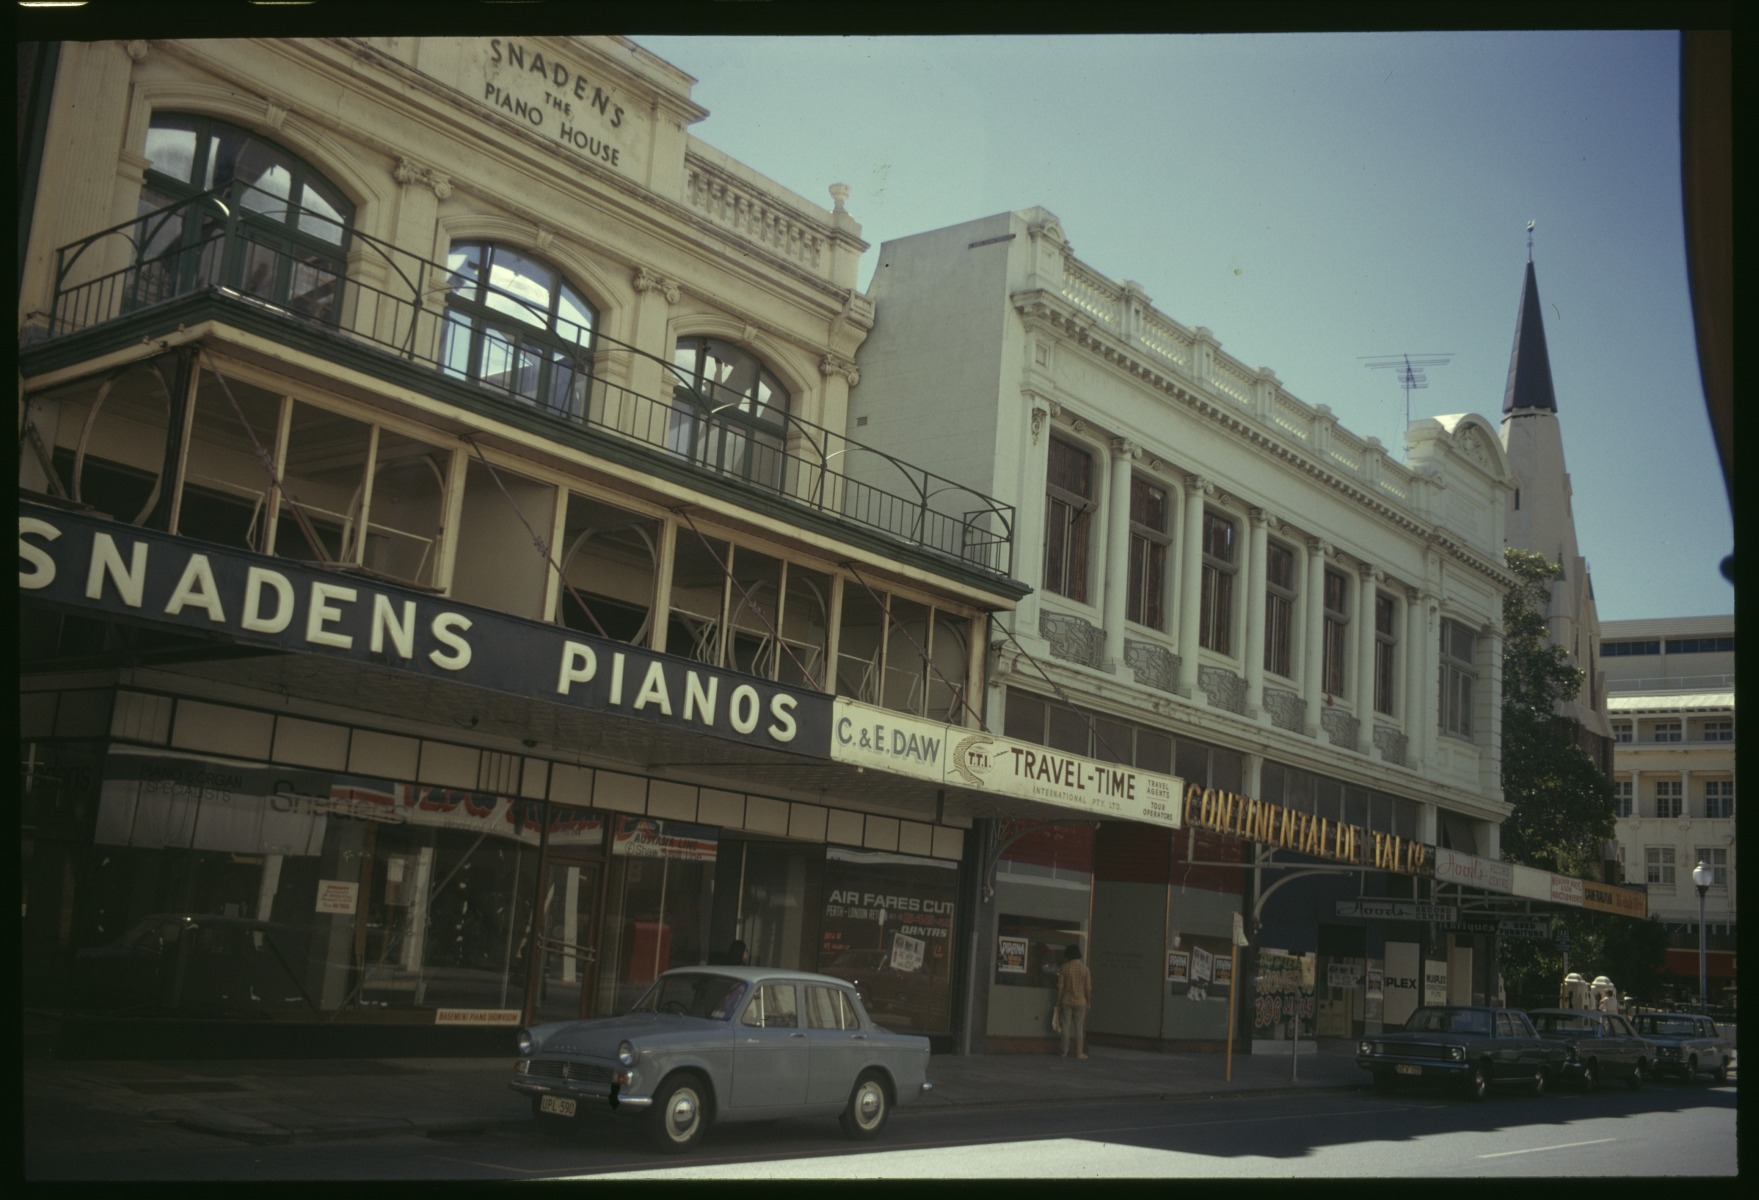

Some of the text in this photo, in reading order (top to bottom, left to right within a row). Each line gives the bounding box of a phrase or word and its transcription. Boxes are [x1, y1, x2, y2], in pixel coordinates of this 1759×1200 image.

[490, 39, 625, 128] SNADENS
[544, 91, 572, 116] THE
[485, 82, 620, 167] PIANO HOUSE
[18, 516, 798, 743] SNADENS PIANOS
[967, 751, 992, 769] T.T.I.
[140, 762, 182, 781] PIANO
[197, 771, 243, 788] ORGAN
[1010, 747, 1136, 800] TRAVEL-TIME
[1147, 779, 1169, 791] TRAVEL
[145, 780, 231, 803] SPECIALISTS
[1032, 785, 1122, 812] INTERNATIONAL PTY. LTD.
[1146, 787, 1170, 800] AGENTS
[1142, 808, 1173, 821] OPERATORS
[1150, 801, 1166, 812] TOUR
[1184, 782, 1327, 857] CONTINENTAL
[1335, 820, 1401, 872] DENTAL
[826, 904, 844, 917] PERTH
[848, 906, 868, 919] LONDON
[828, 889, 955, 915] AIR FARES CUT
[1415, 906, 1451, 914] RECORD
[1415, 912, 1451, 920] CENTRE
[900, 924, 949, 938] QANTAS
[1500, 928, 1544, 937] FURNITURE
[1254, 996, 1281, 1029] 396
